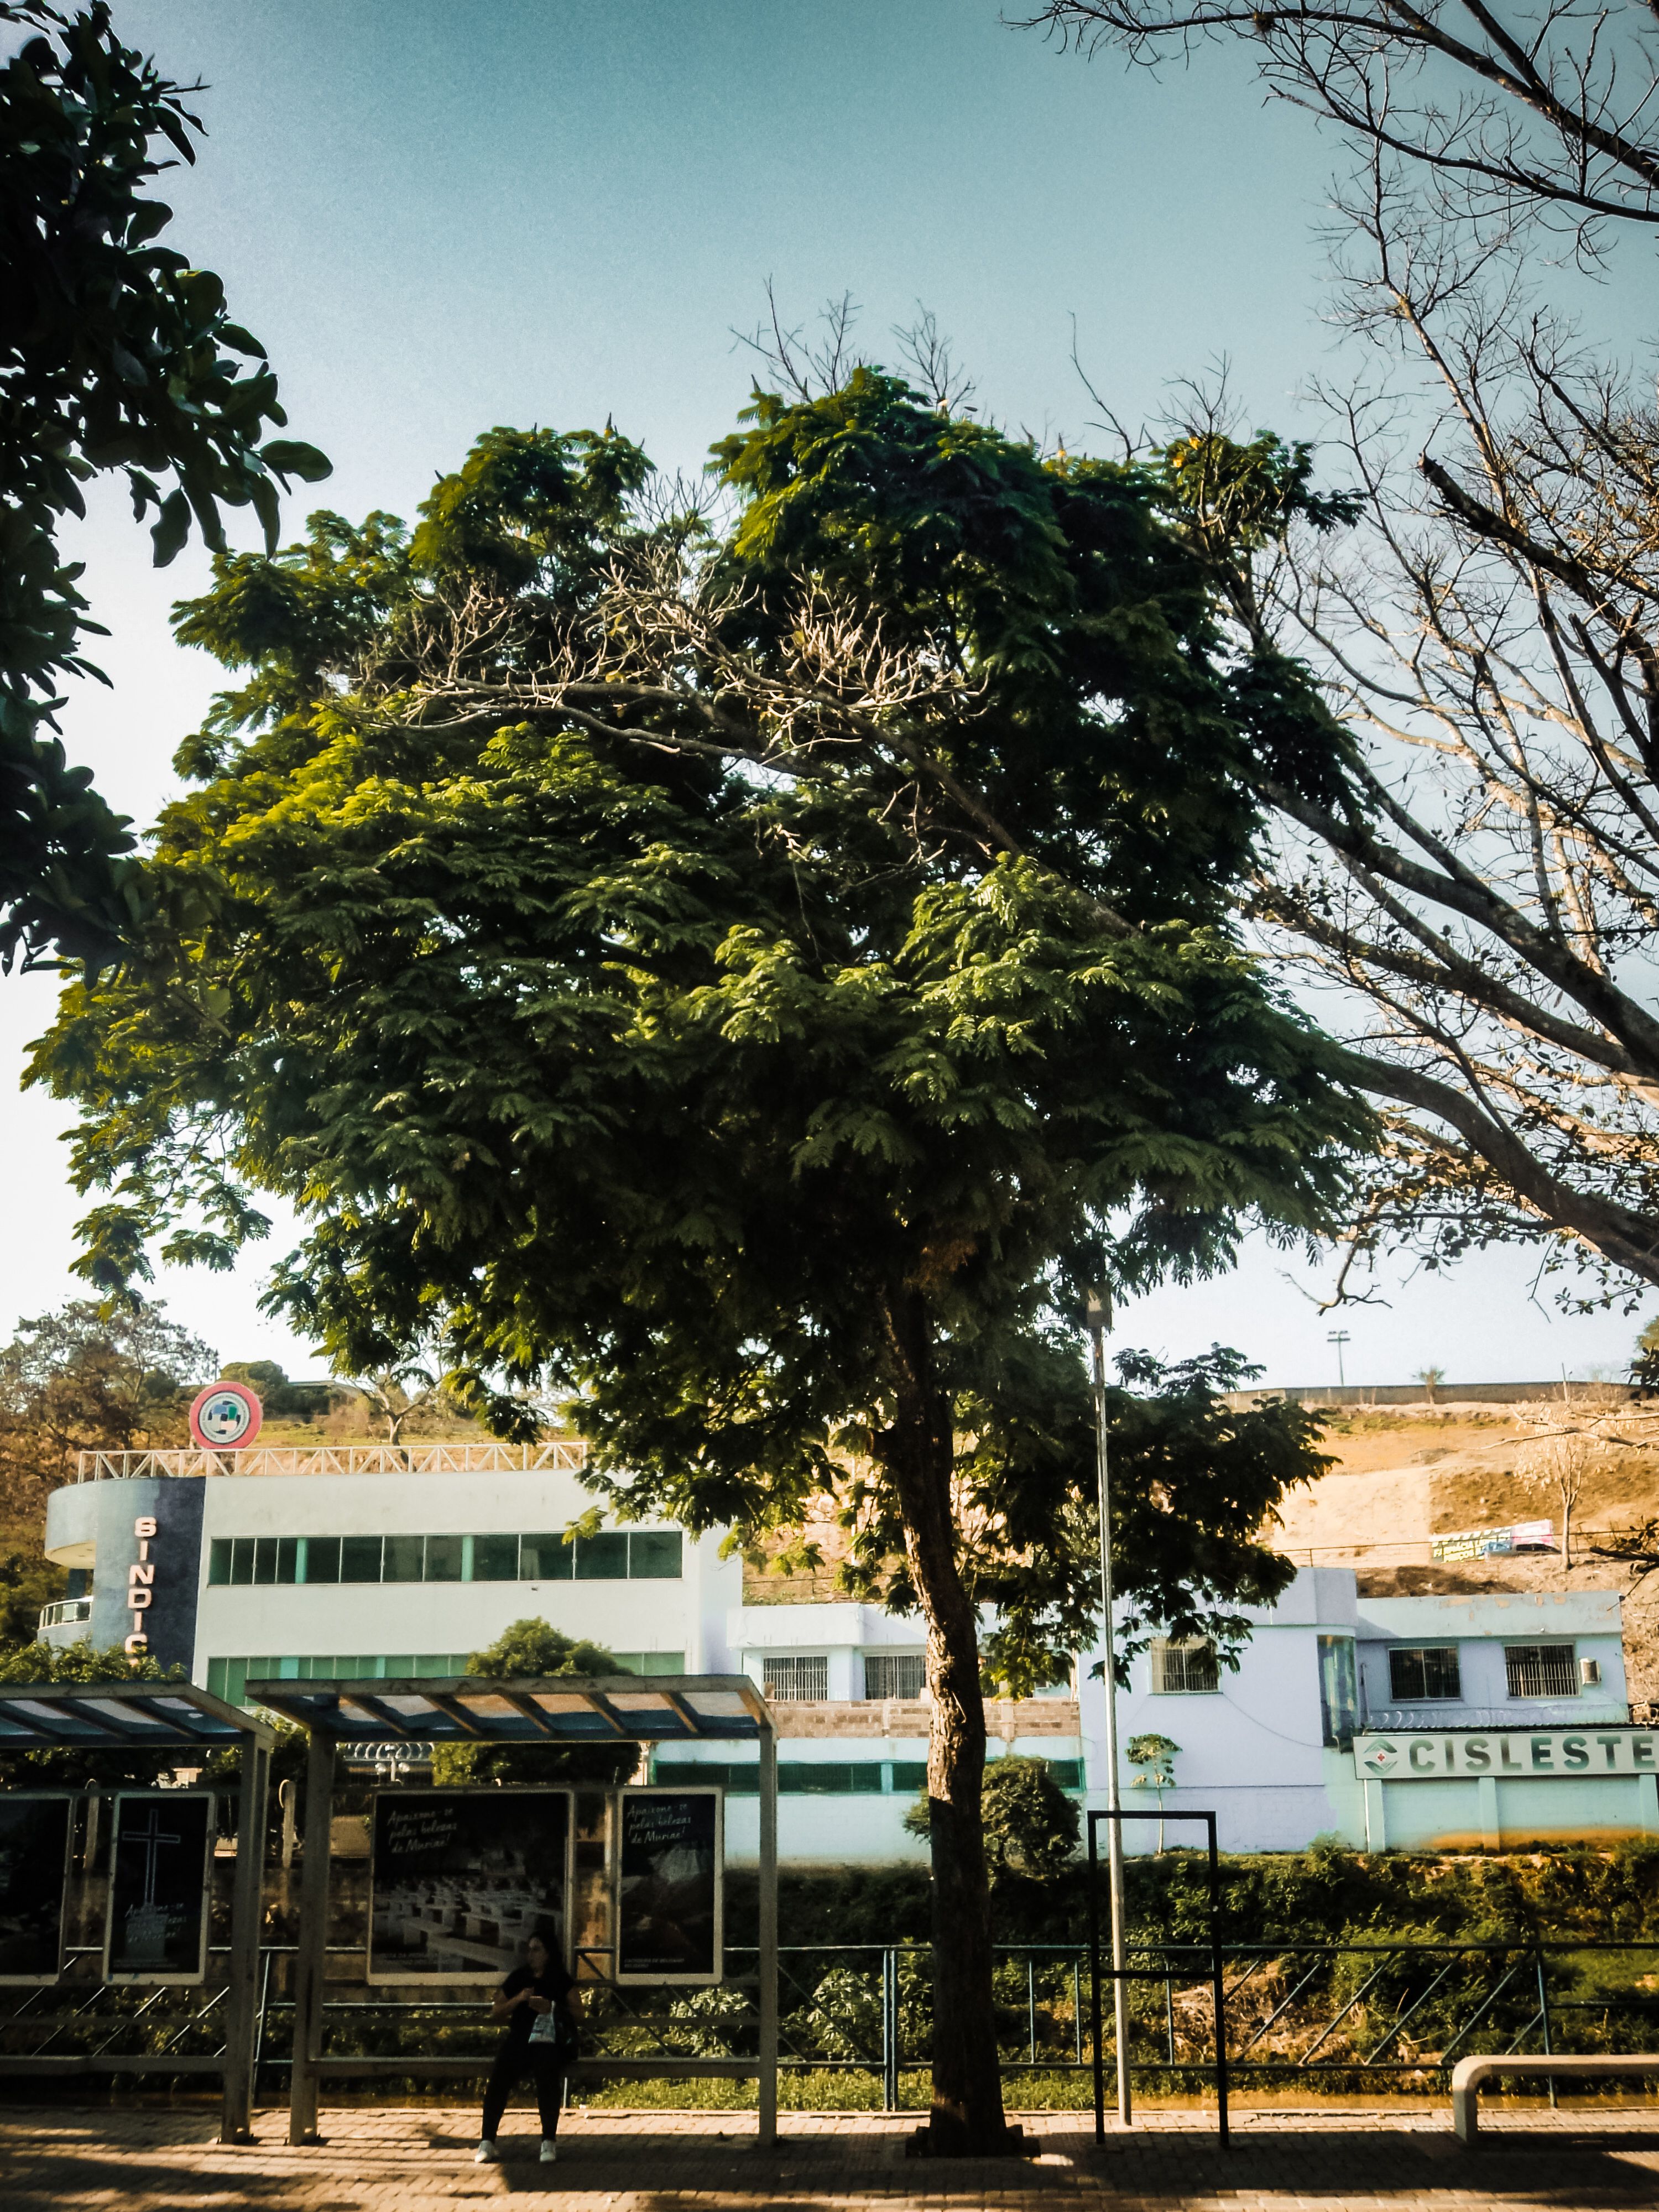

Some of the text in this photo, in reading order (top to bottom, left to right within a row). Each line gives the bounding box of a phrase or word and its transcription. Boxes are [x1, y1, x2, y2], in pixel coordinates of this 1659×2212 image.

[124, 1516, 157, 1667] SINDIC
[1409, 1736, 1656, 1772] CISLESTE
[658, 1813, 691, 1826] belezas
